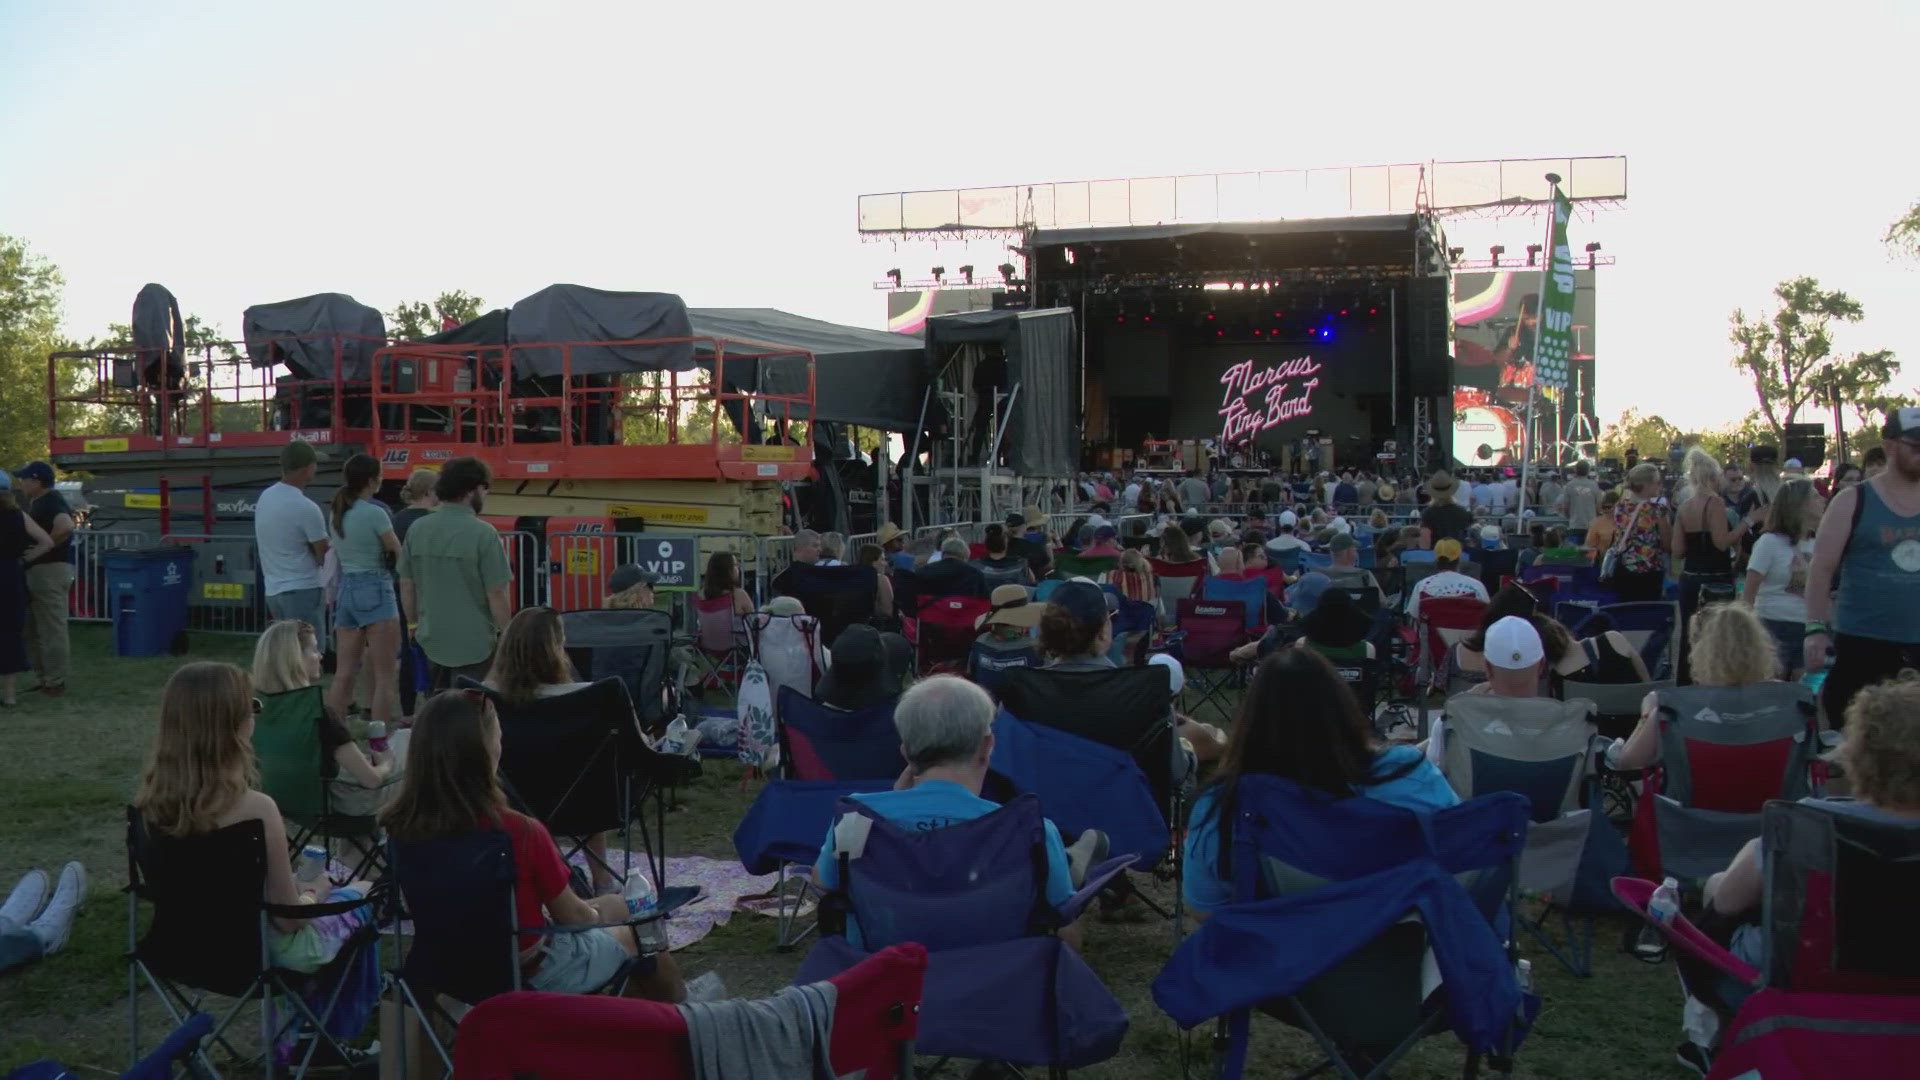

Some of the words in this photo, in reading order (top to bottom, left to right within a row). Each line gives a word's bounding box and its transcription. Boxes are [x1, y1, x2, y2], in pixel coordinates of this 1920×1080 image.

[1546, 308, 1571, 332] VIP
[1220, 355, 1322, 407] Marcus
[1218, 397, 1265, 444] King
[1262, 377, 1319, 430] Band
[382, 449, 409, 463] JLG
[217, 499, 258, 513] SKYJAC
[647, 560, 686, 574] VIP
